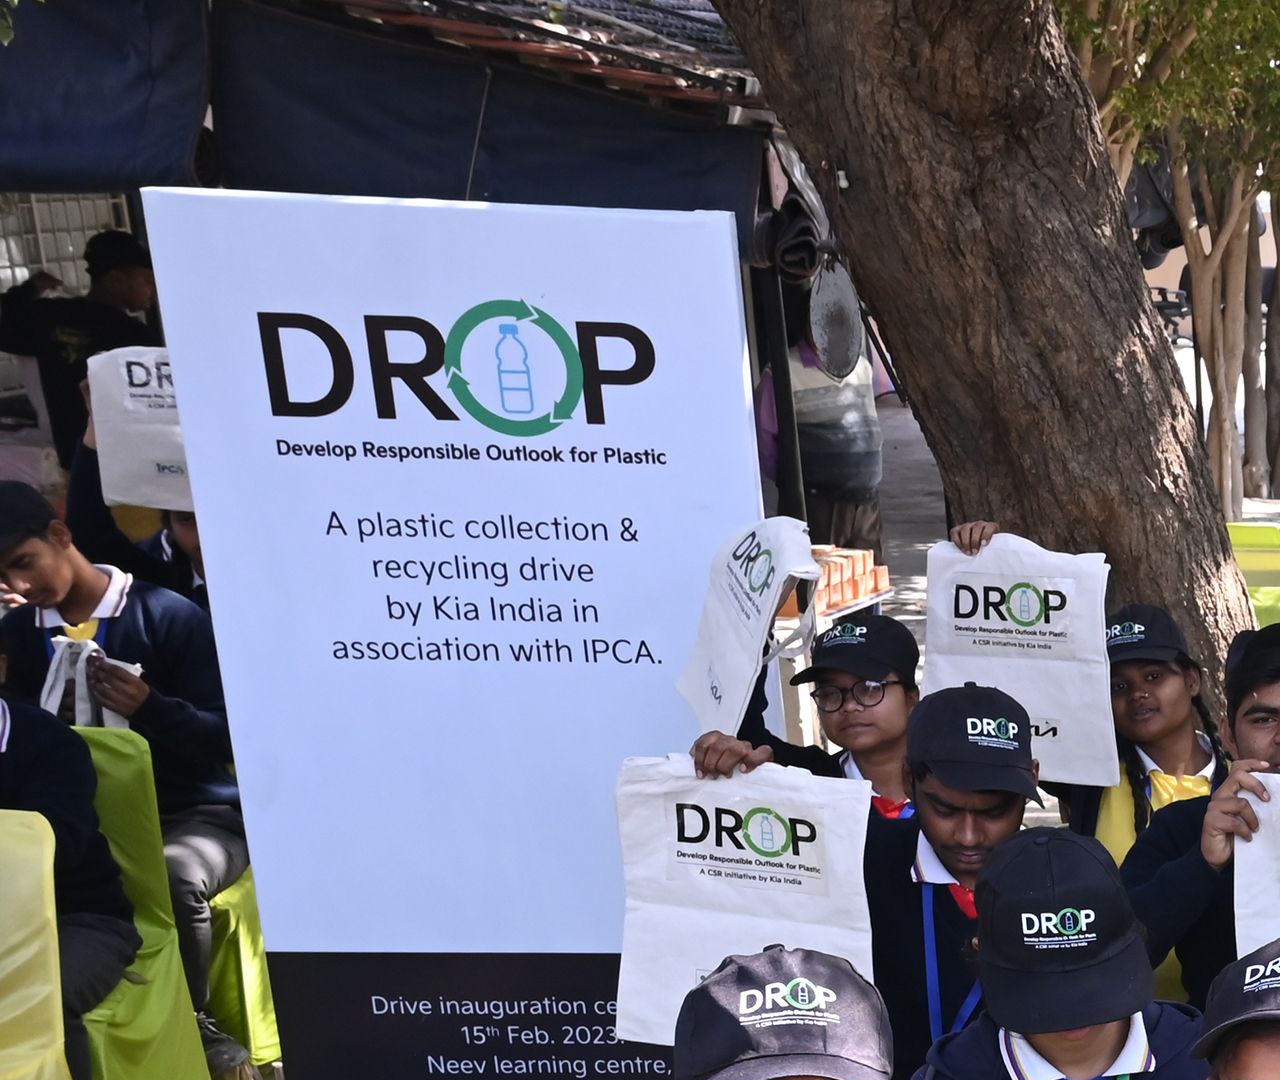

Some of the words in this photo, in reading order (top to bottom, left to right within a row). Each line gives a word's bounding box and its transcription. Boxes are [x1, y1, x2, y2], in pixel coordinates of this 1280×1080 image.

[257, 299, 656, 437] DROP
[275, 439, 357, 462] Develop
[362, 441, 481, 463] Responsible
[485, 444, 565, 463] Outlook
[568, 446, 598, 464] for
[603, 447, 667, 465] Plastic
[326, 510, 348, 536] A
[357, 511, 455, 543] plastic
[464, 514, 609, 542] collection
[619, 517, 639, 542] &
[372, 554, 509, 588] recycling
[519, 556, 594, 583] drive
[386, 594, 422, 627] by
[432, 595, 480, 622] Kia
[489, 596, 563, 623] India
[572, 598, 599, 623] in
[954, 582, 1067, 627] DROP
[823, 623, 867, 642] DROP
[332, 636, 500, 662] association
[508, 638, 573, 663] with
[582, 638, 663, 665] IPCA.
[966, 717, 1019, 739] DROP
[675, 802, 817, 858] DROP
[1021, 907, 1096, 935] DROP
[371, 996, 433, 1016] Drive
[439, 996, 588, 1020] inauguration
[739, 977, 837, 1014] DROP
[507, 1026, 555, 1045] Feb.
[427, 1055, 486, 1075] Neev
[494, 1055, 588, 1079] learning
[594, 1056, 673, 1078] centre,
